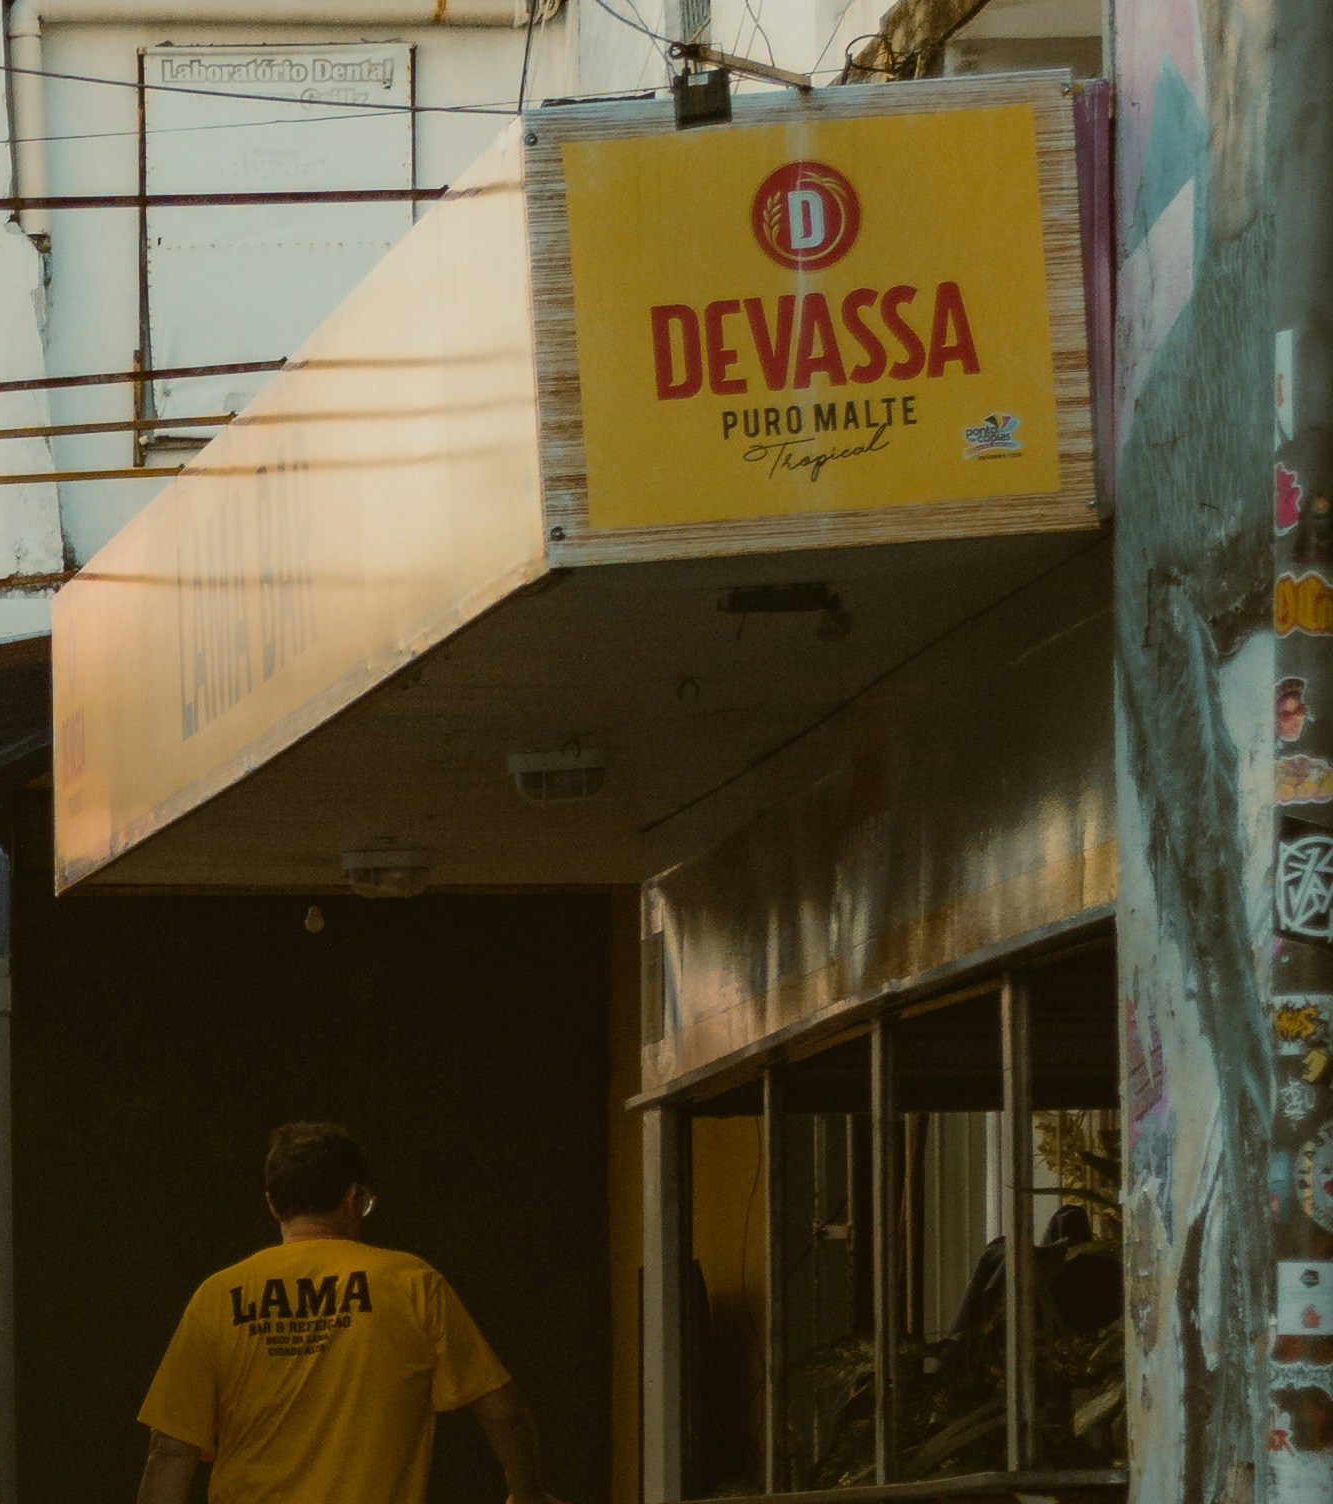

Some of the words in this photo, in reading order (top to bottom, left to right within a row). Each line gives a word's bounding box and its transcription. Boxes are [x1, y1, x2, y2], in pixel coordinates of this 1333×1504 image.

[161, 58, 308, 83] Laboratório
[313, 58, 394, 84] Dental
[788, 190, 824, 249] D
[650, 281, 980, 400] DEVASSA
[722, 405, 803, 439] PURO
[814, 396, 917, 432] MALTE
[743, 423, 890, 482] Tropical
[229, 1271, 372, 1326] LAMA
[249, 1322, 271, 1335] BAR
